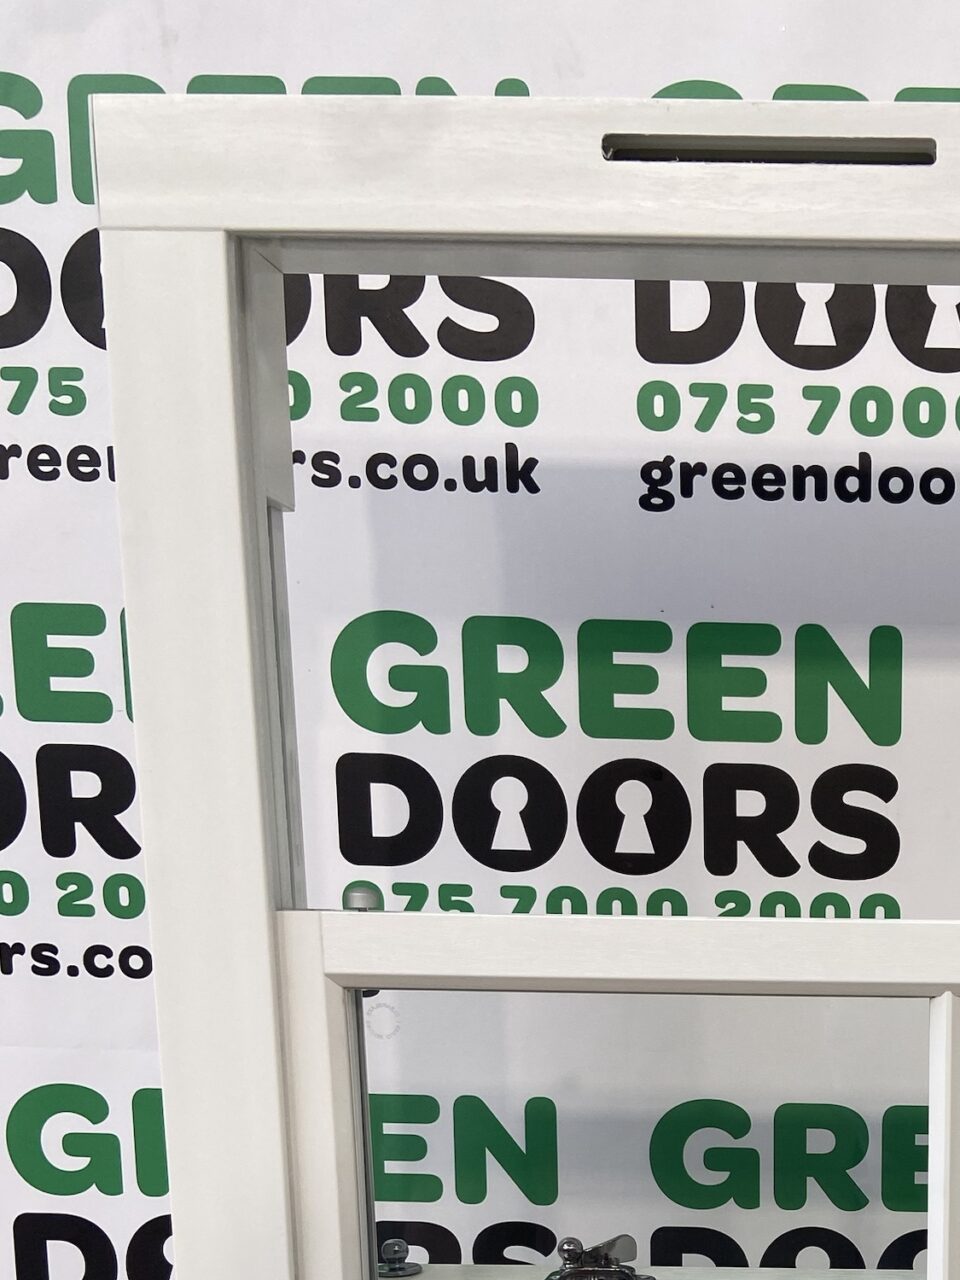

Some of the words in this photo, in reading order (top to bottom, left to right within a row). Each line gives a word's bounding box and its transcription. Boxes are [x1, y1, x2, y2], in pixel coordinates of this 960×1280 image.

[339, 371, 540, 427] 2000
[636, 380, 775, 434] 075
[330, 610, 903, 747] GREEN
[335, 752, 901, 881] DOORS
